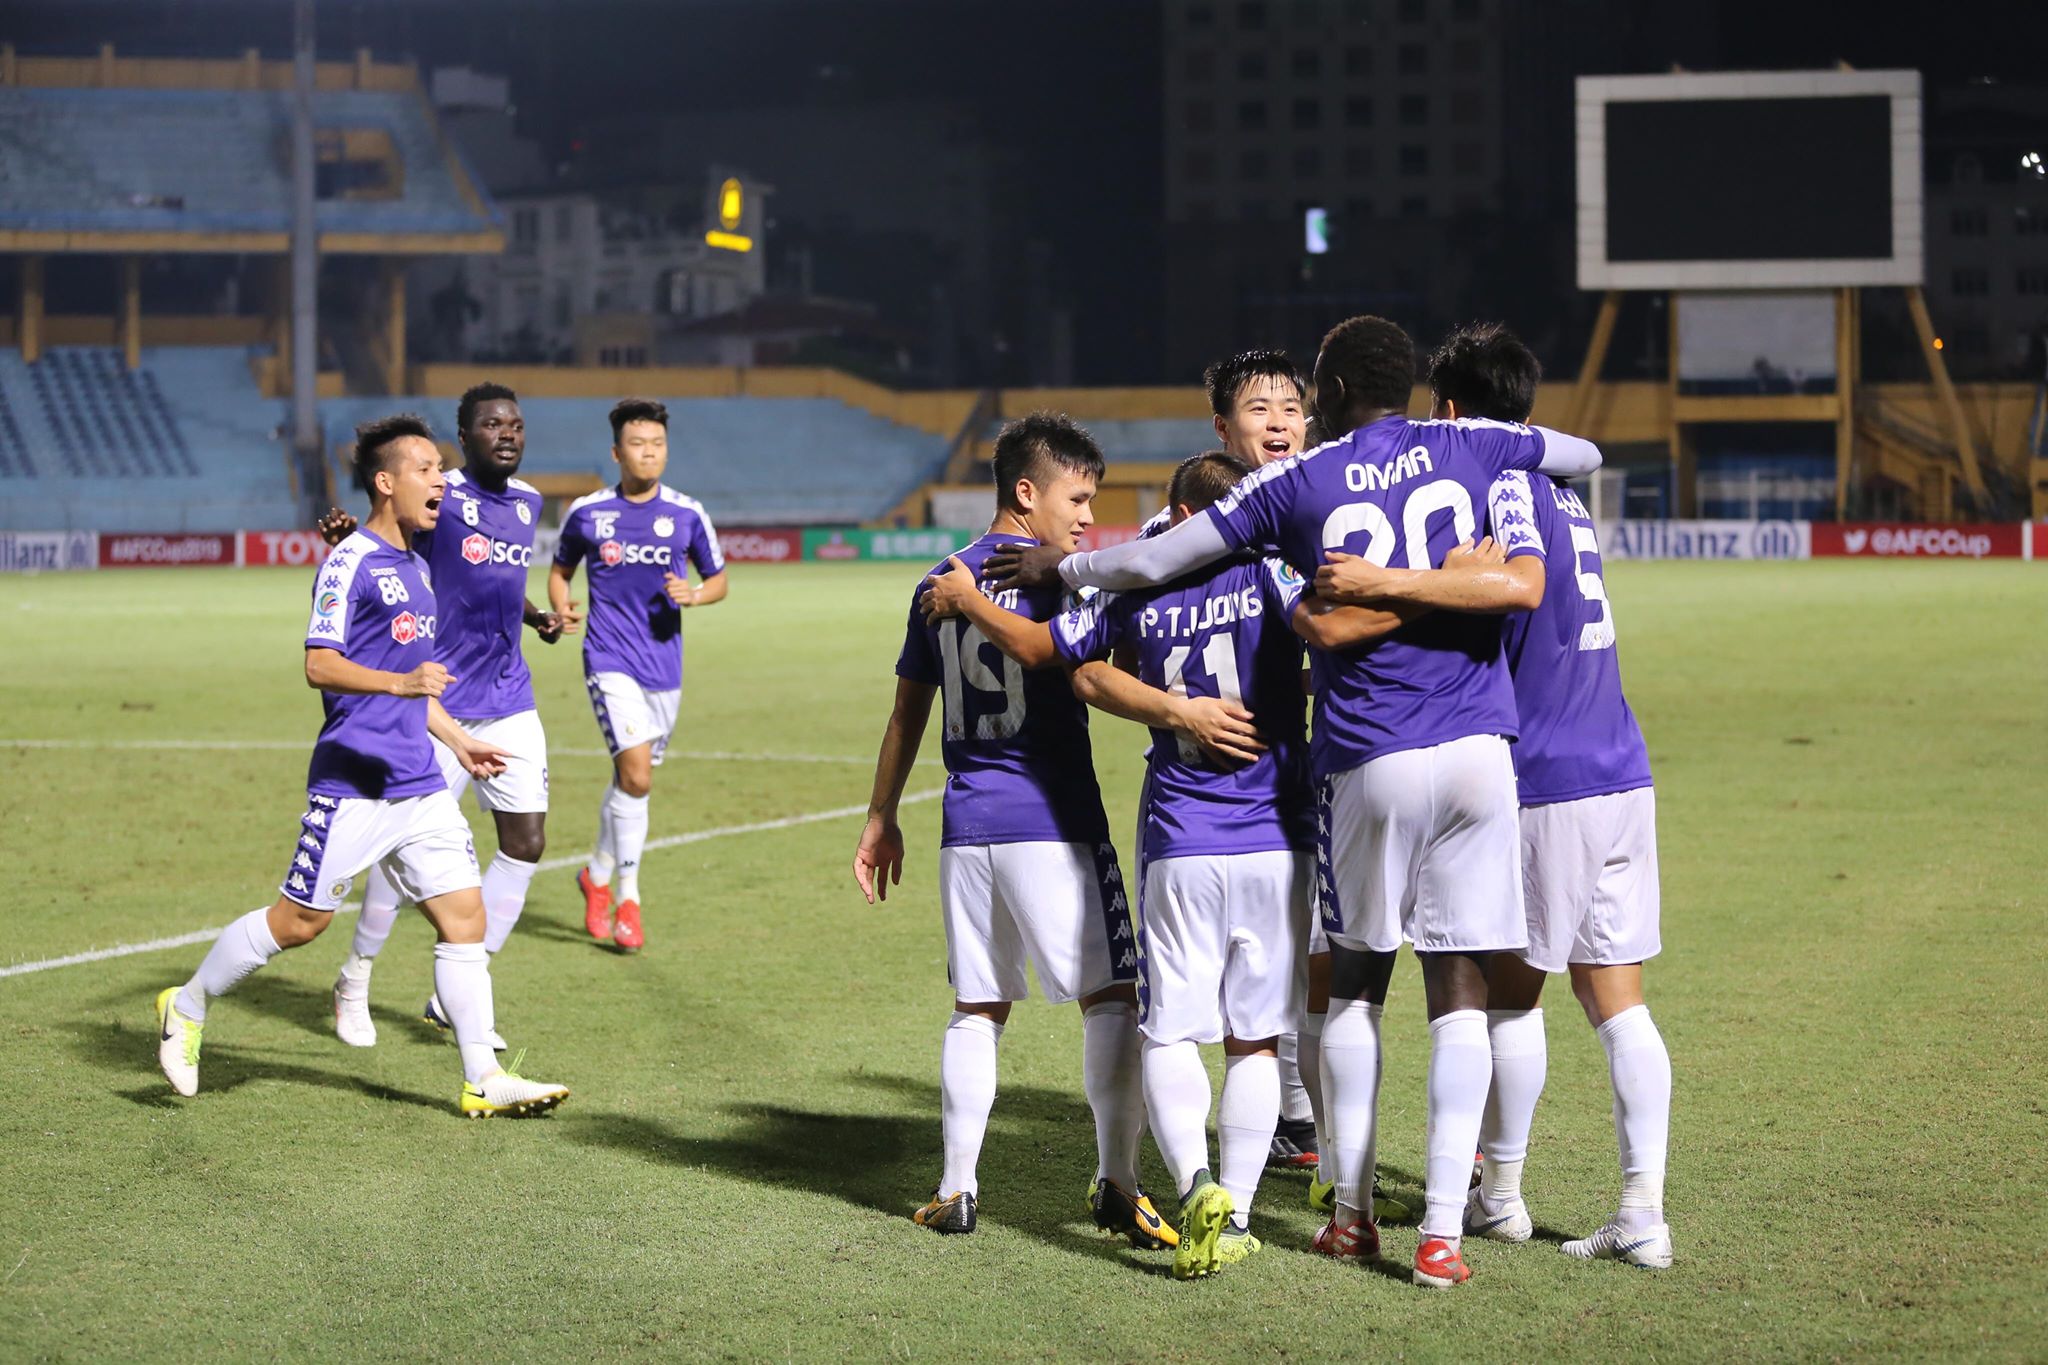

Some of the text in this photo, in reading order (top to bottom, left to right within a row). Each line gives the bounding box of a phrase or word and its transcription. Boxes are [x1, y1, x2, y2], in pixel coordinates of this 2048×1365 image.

[1345, 446, 1433, 492] OMAR
[462, 501, 480, 527] 8
[595, 519, 617, 539] 16
[261, 531, 331, 566] TOY
[626, 544, 671, 565] SCG
[1606, 523, 1740, 556] Allianz
[1871, 528, 1992, 558] @AFCCup
[378, 575, 409, 605] 88
[1569, 523, 1616, 650] 5
[417, 615, 436, 638] SC
[937, 618, 1027, 741] 19
